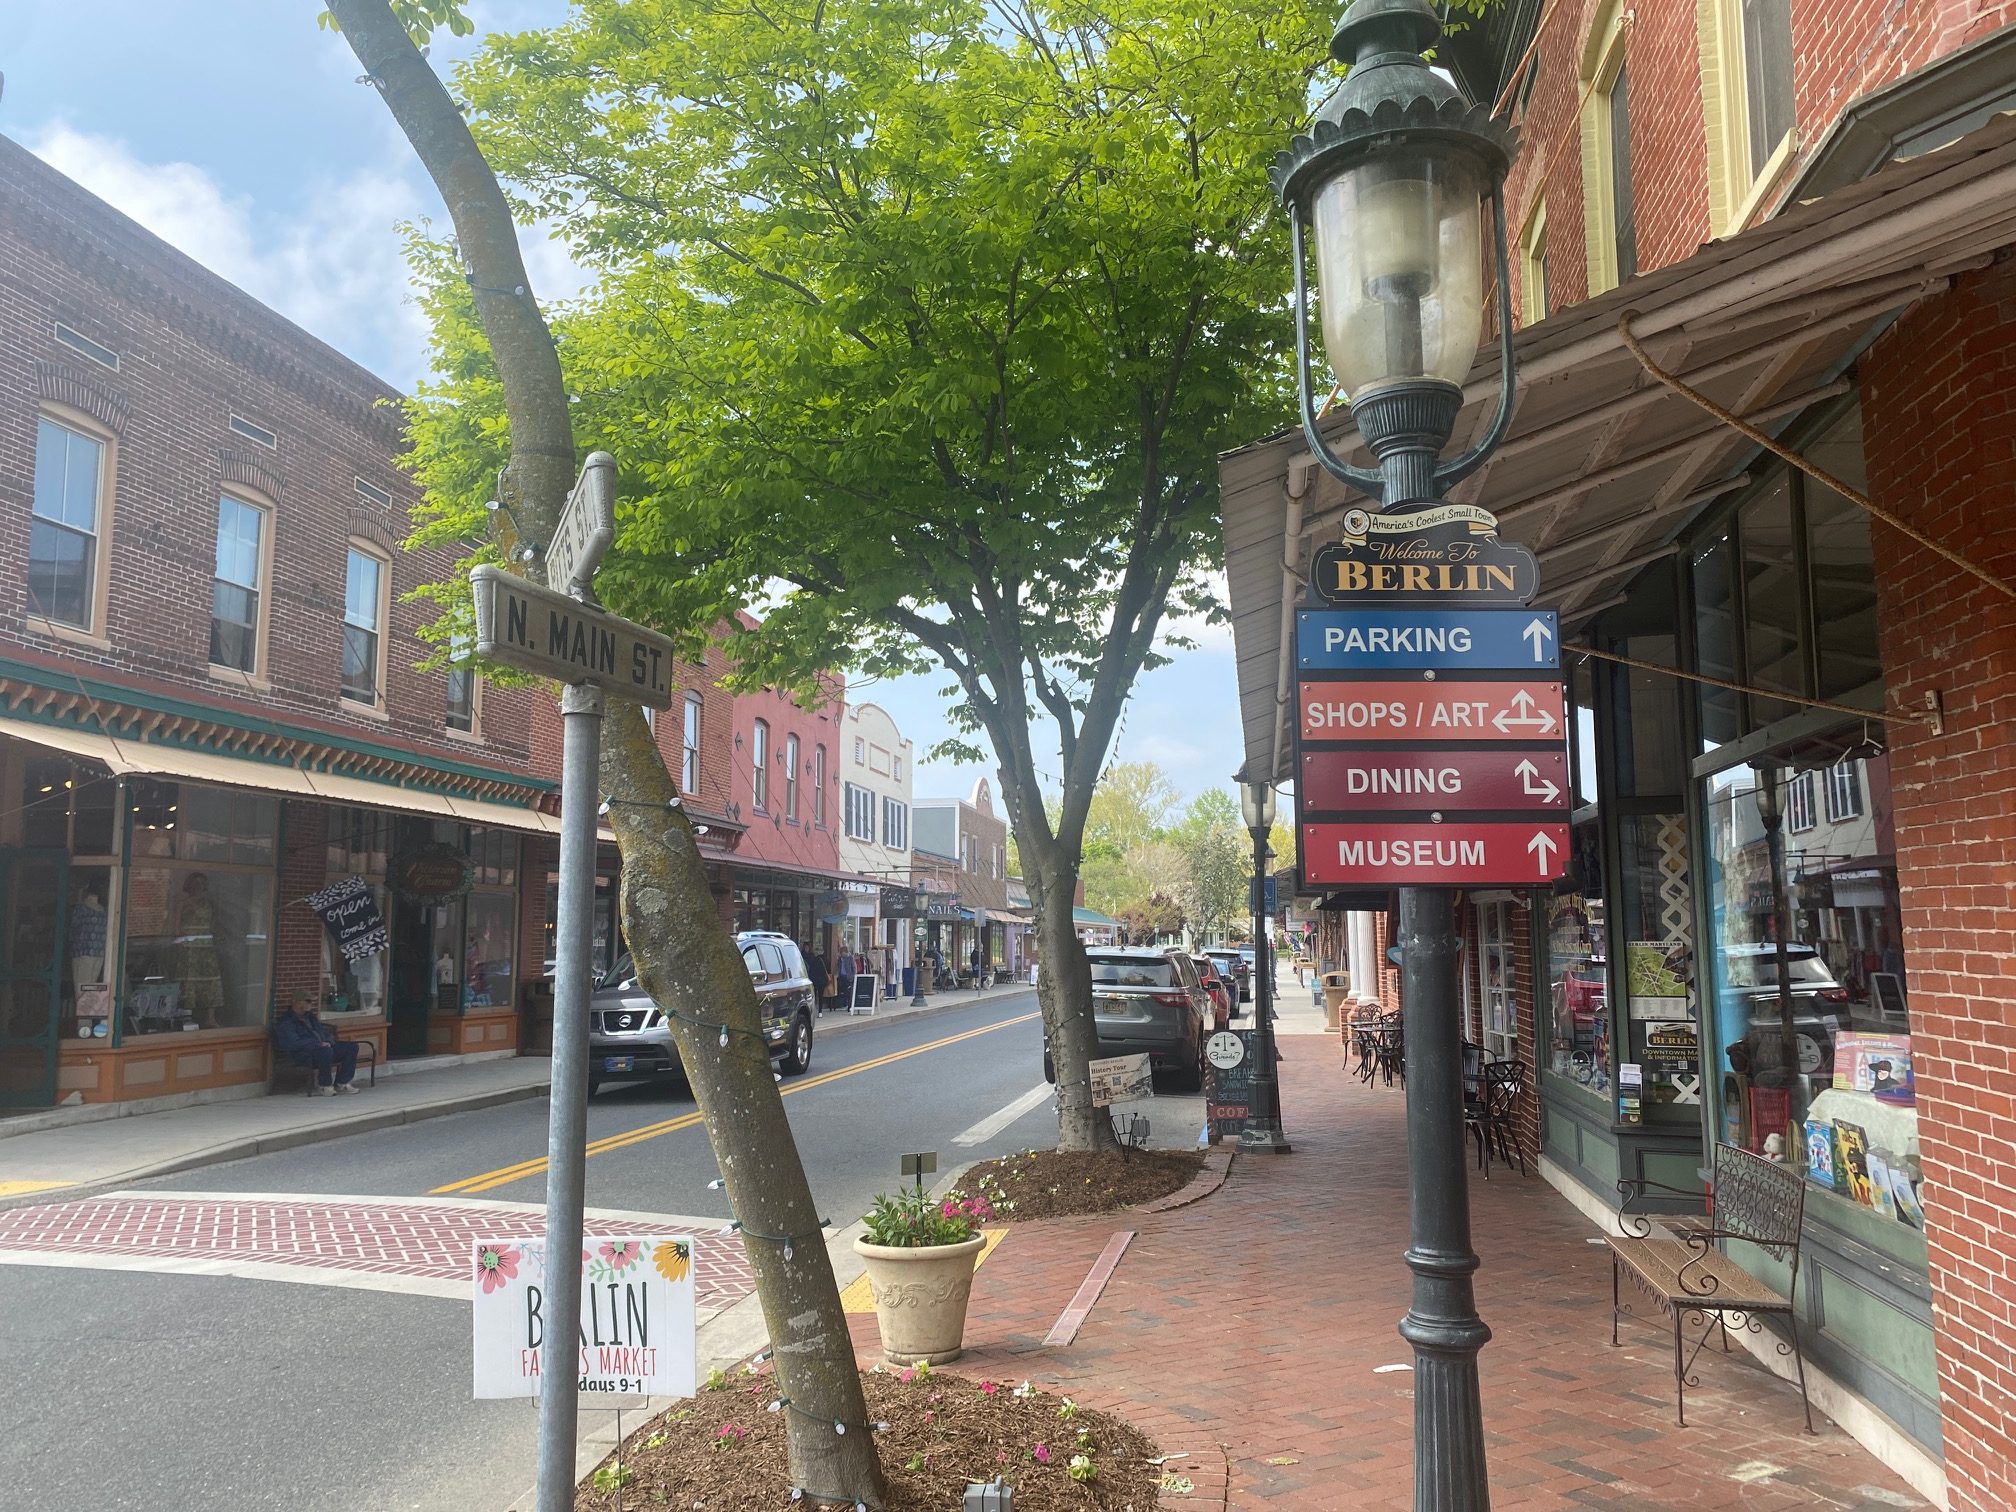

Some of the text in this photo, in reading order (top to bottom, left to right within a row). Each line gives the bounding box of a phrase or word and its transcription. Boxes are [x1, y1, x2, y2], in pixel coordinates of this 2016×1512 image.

[574, 488, 592, 550] ST.
[1372, 507, 1493, 530] America's Coolest Small Town
[1369, 538, 1483, 562] Welcome To
[1333, 560, 1517, 591] BERLIN
[508, 595, 535, 650] N.
[550, 611, 615, 675] MAIN
[632, 642, 664, 692] ST.
[1325, 627, 1472, 653] PARKING
[1307, 702, 1489, 728] SHOPS / ART
[1347, 768, 1462, 794] DINING
[1338, 840, 1485, 866] MUSEUM
[326, 896, 371, 925] open
[929, 905, 960, 915] NAILS
[340, 921, 367, 939] come
[1652, 1036, 1697, 1045] BERLIN
[1216, 1107, 1248, 1117] COF
[527, 1282, 648, 1349] BLIN
[600, 1347, 657, 1377] MARKET
[578, 1377, 642, 1394] days 9-1
